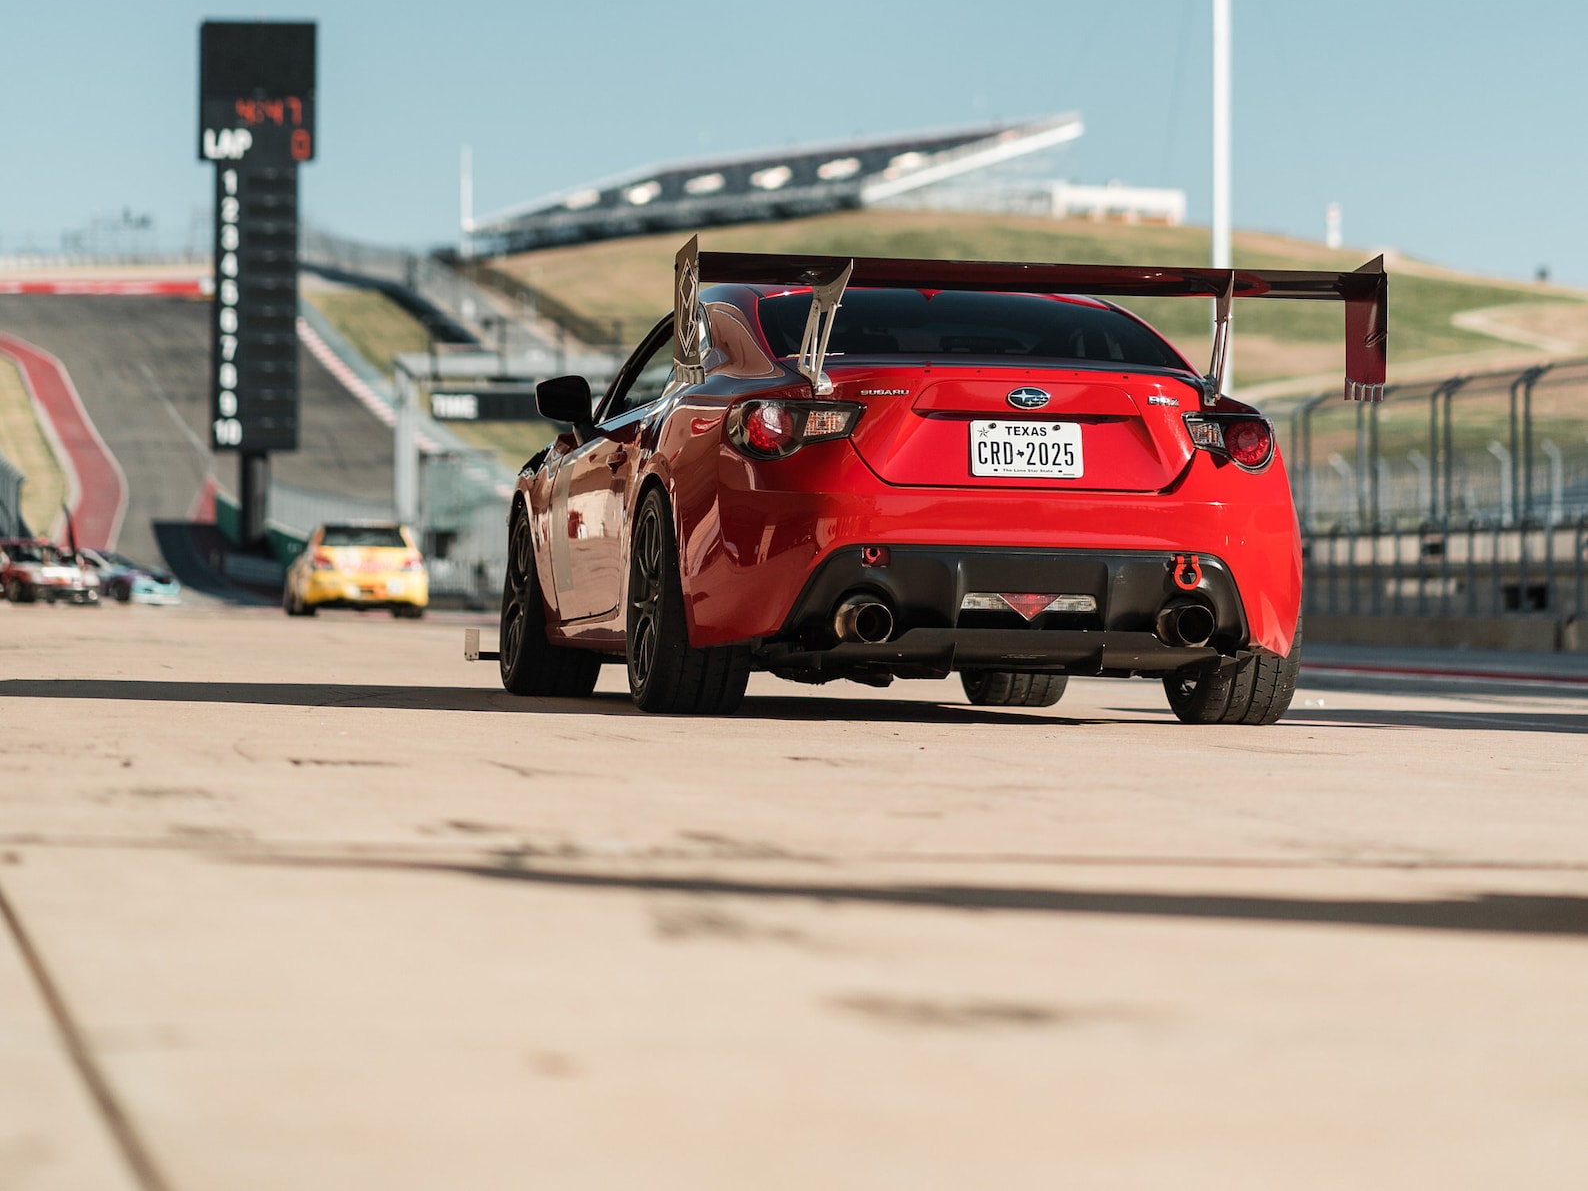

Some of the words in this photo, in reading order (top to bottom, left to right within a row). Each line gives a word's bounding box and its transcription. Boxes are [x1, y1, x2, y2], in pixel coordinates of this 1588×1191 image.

[203, 127, 253, 160] LAP
[223, 169, 238, 196] 1
[221, 196, 239, 223] 2
[221, 224, 239, 251] 3
[220, 251, 239, 278] 4
[220, 278, 239, 306] 5
[219, 306, 239, 334] 6
[220, 334, 238, 361] 7
[219, 362, 238, 390] 8
[219, 390, 238, 417] 9
[214, 418, 243, 445] 10
[1005, 426, 1047, 437] TEXAS
[977, 441, 1014, 465] CRD
[1026, 442, 1074, 467] 2025
